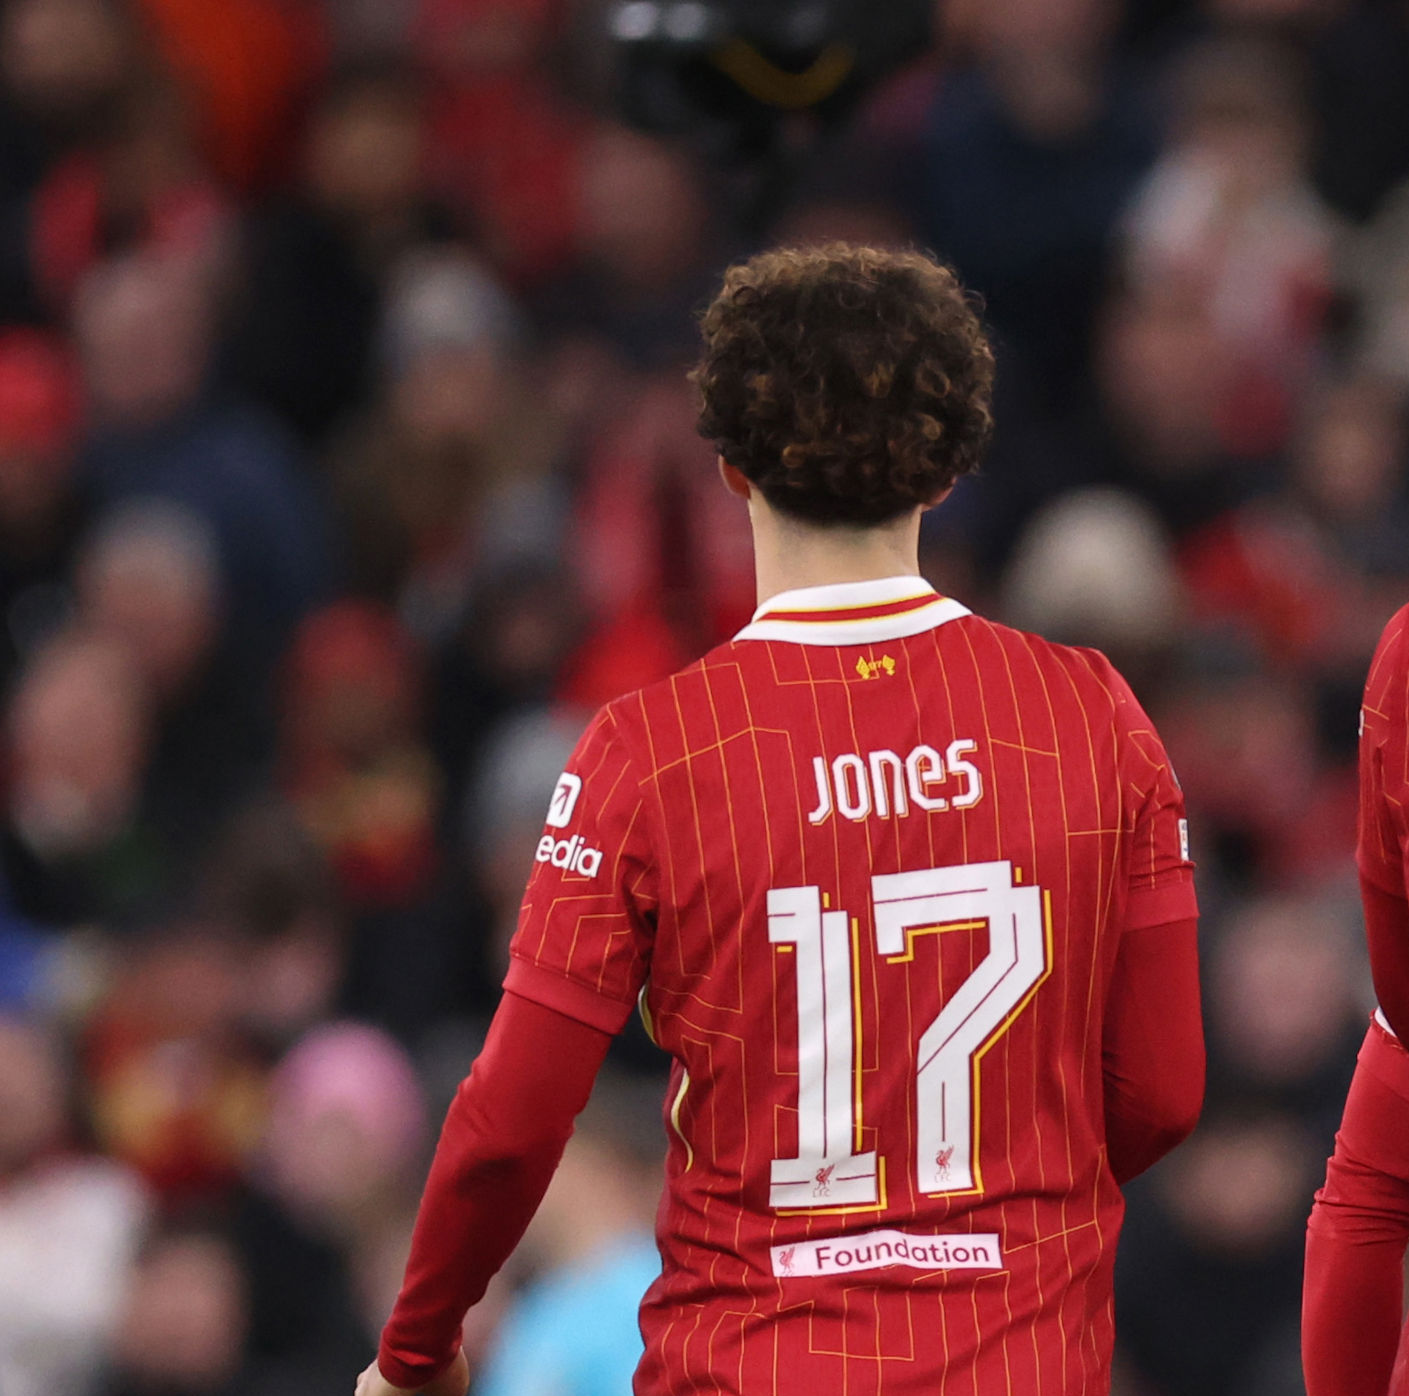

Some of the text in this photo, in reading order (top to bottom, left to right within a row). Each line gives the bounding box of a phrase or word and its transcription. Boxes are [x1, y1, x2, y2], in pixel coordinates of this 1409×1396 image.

[808, 738, 983, 826] JONES
[535, 834, 603, 878] edia
[767, 860, 1053, 1216] 17
[815, 1238, 990, 1269] Foundation
